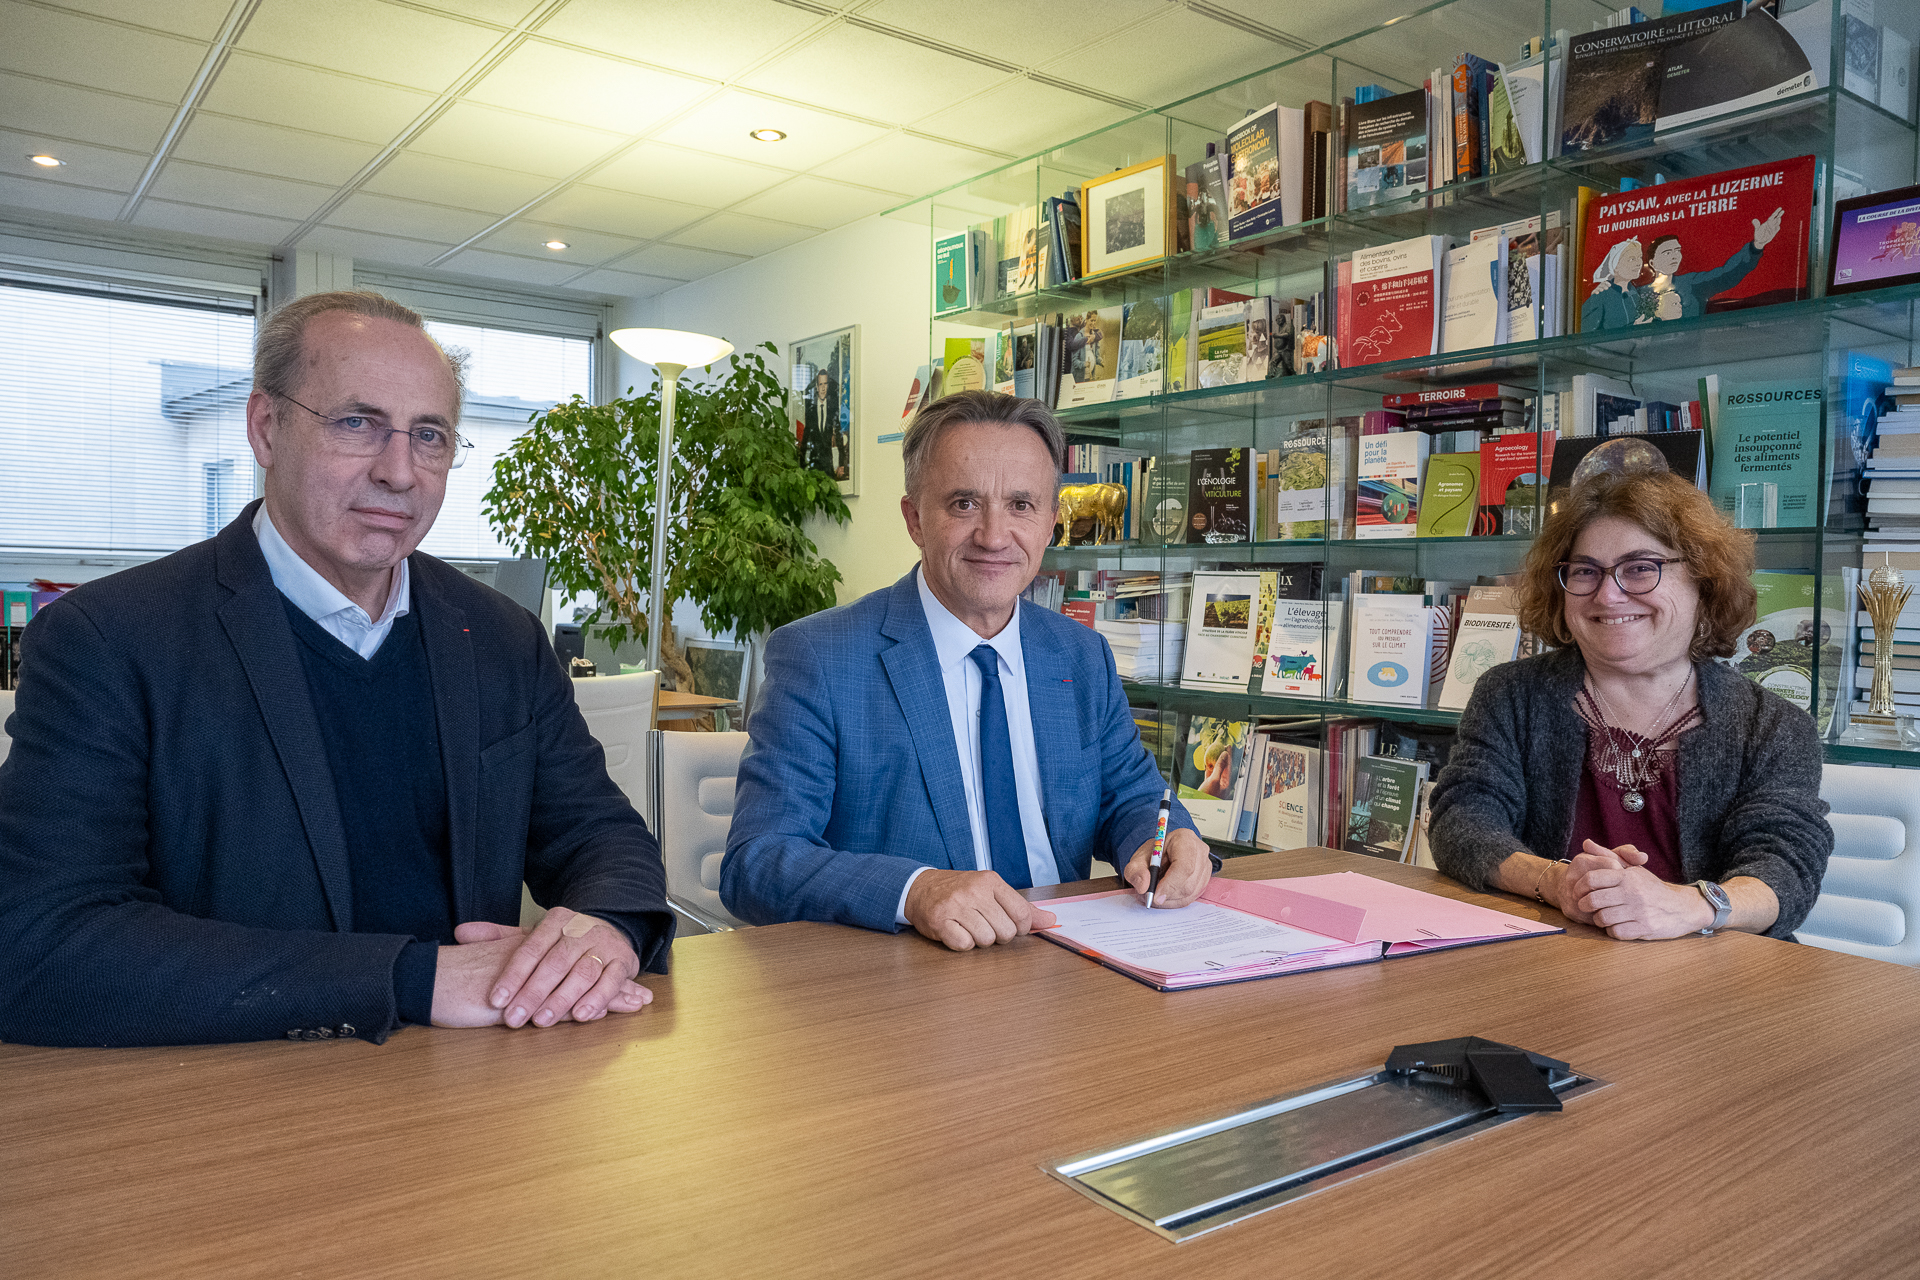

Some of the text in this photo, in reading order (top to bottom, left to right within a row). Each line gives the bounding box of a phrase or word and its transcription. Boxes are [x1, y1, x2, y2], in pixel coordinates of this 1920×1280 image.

[1574, 27, 1665, 54] CONSERVATOIRE
[1677, 12, 1735, 33] LITTORAL
[1667, 64, 1683, 72] ATLAS
[1776, 80, 1803, 96] demeter
[1230, 126, 1251, 143] HANDBOOK
[1230, 128, 1265, 152] MOLECULAR
[1599, 171, 1784, 219] PAYSAN, AVEC LA LUZERNE
[1597, 196, 1738, 235] TU NOURRIRAS LA TERRE
[1866, 212, 1889, 220] COURSE
[1360, 249, 1396, 260] Alimentation
[1392, 253, 1408, 261] ovins
[1366, 263, 1389, 273] caprins
[1418, 388, 1466, 402] TERROIRS
[1738, 430, 1800, 444] Le potentiel
[1375, 440, 1388, 449] défi
[1494, 444, 1529, 452] Agroecology
[1734, 441, 1802, 453] insoupçonné
[1364, 448, 1387, 458] pour la
[1734, 452, 1800, 462] des aliments
[1364, 455, 1387, 465] planète
[1740, 462, 1792, 472] fermentés
[1204, 490, 1242, 498] VITICULTURE
[1287, 607, 1326, 619] L'élevage
[1291, 616, 1325, 625] l'agroécologi
[1463, 619, 1511, 629] BIODIVERSITÉ
[1382, 628, 1412, 636] COMPRENDRE
[1388, 641, 1407, 649] CLIMAT
[1385, 797, 1402, 805] climat
[1278, 800, 1304, 814] SCIENCE
[1381, 802, 1400, 811] change
